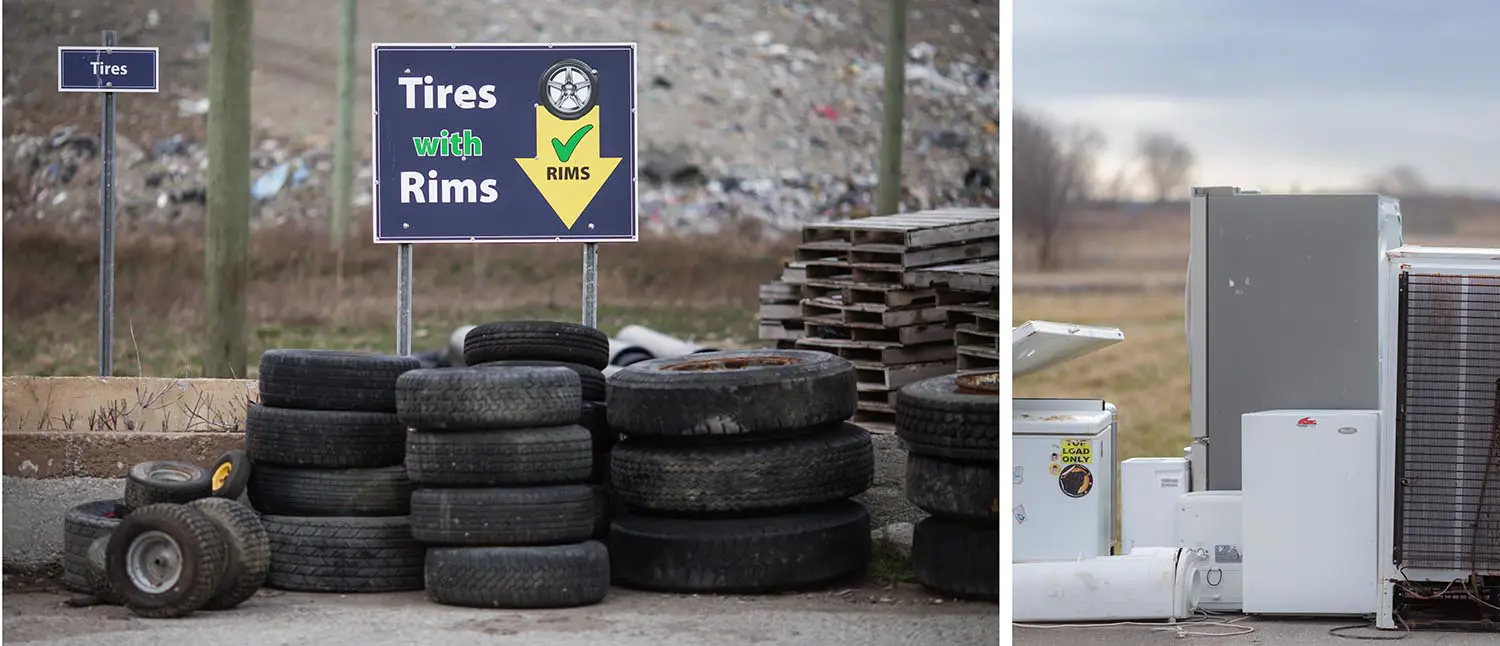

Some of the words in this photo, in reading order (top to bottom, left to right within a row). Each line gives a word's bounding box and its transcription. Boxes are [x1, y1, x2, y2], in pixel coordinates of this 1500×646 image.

[90, 61, 128, 75] Tires
[398, 75, 497, 109] Tires
[412, 129, 482, 156] with
[400, 169, 499, 203] Rims
[546, 166, 590, 180] RIMS
